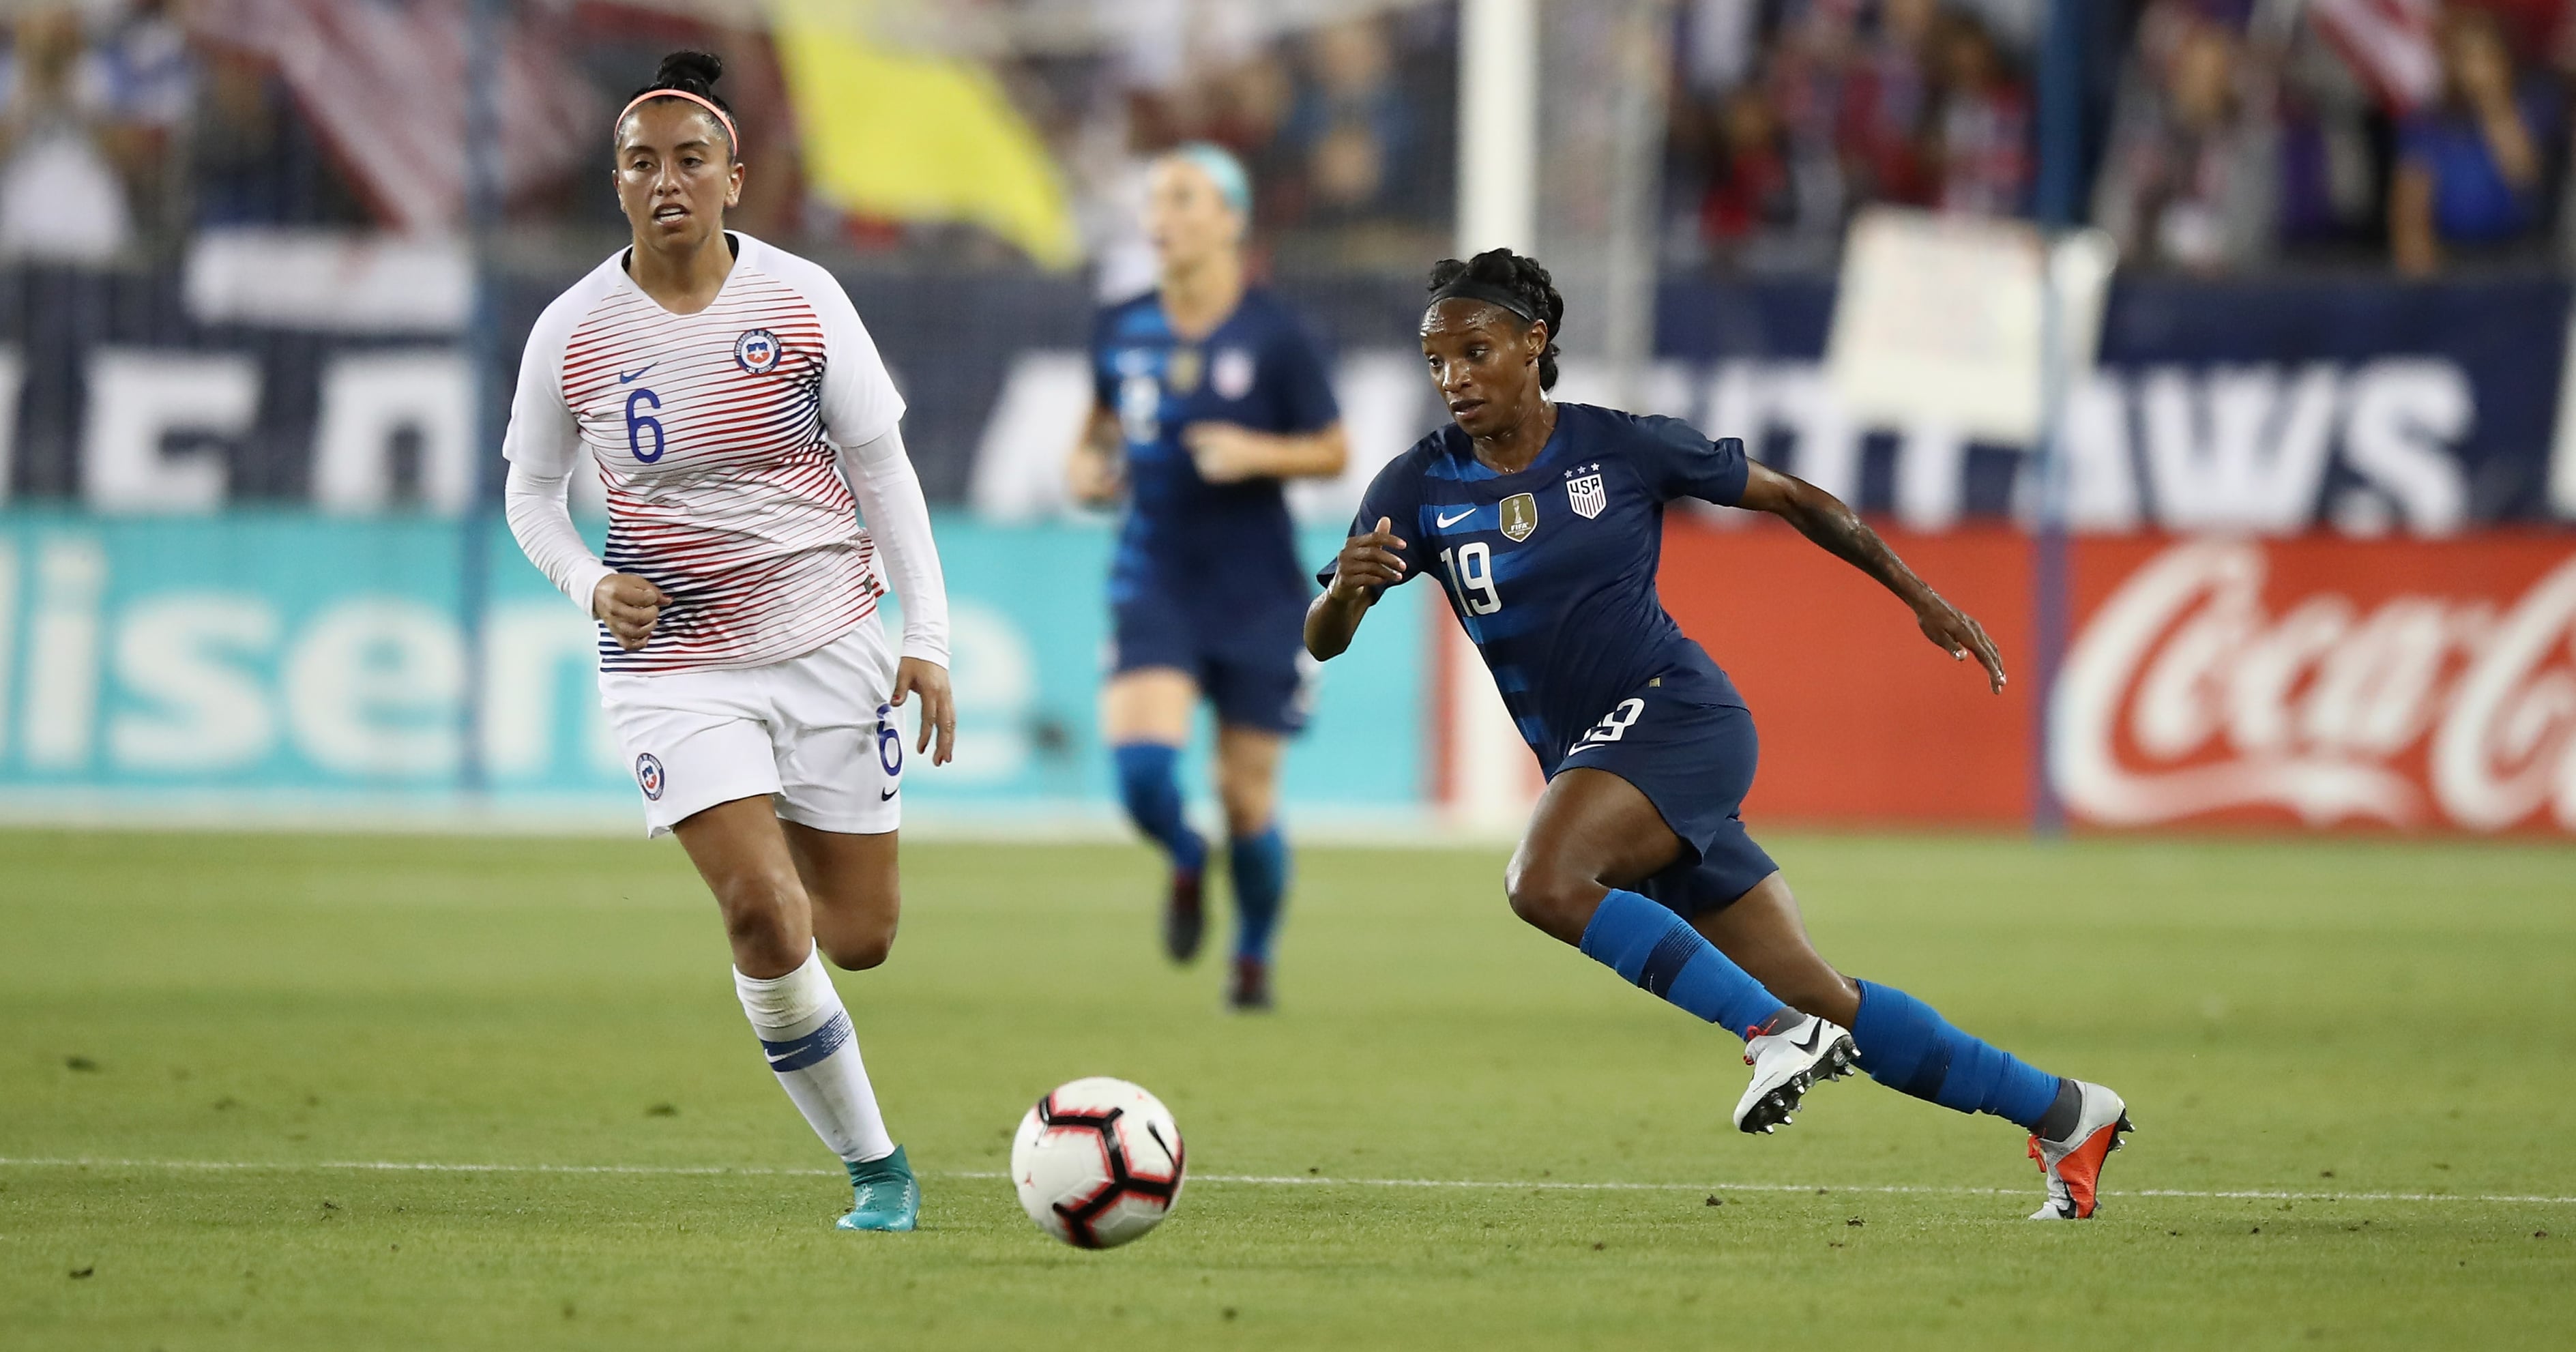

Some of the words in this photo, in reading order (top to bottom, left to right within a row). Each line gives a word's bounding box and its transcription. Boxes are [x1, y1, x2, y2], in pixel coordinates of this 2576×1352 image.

[626, 388, 664, 464] 6
[1570, 477, 1600, 495] USA
[1510, 523, 1529, 531] FIFA
[1439, 542, 1502, 617] 19
[0, 535, 1034, 774] isene
[877, 703, 903, 776] 6
[1581, 698, 1645, 742] 9
